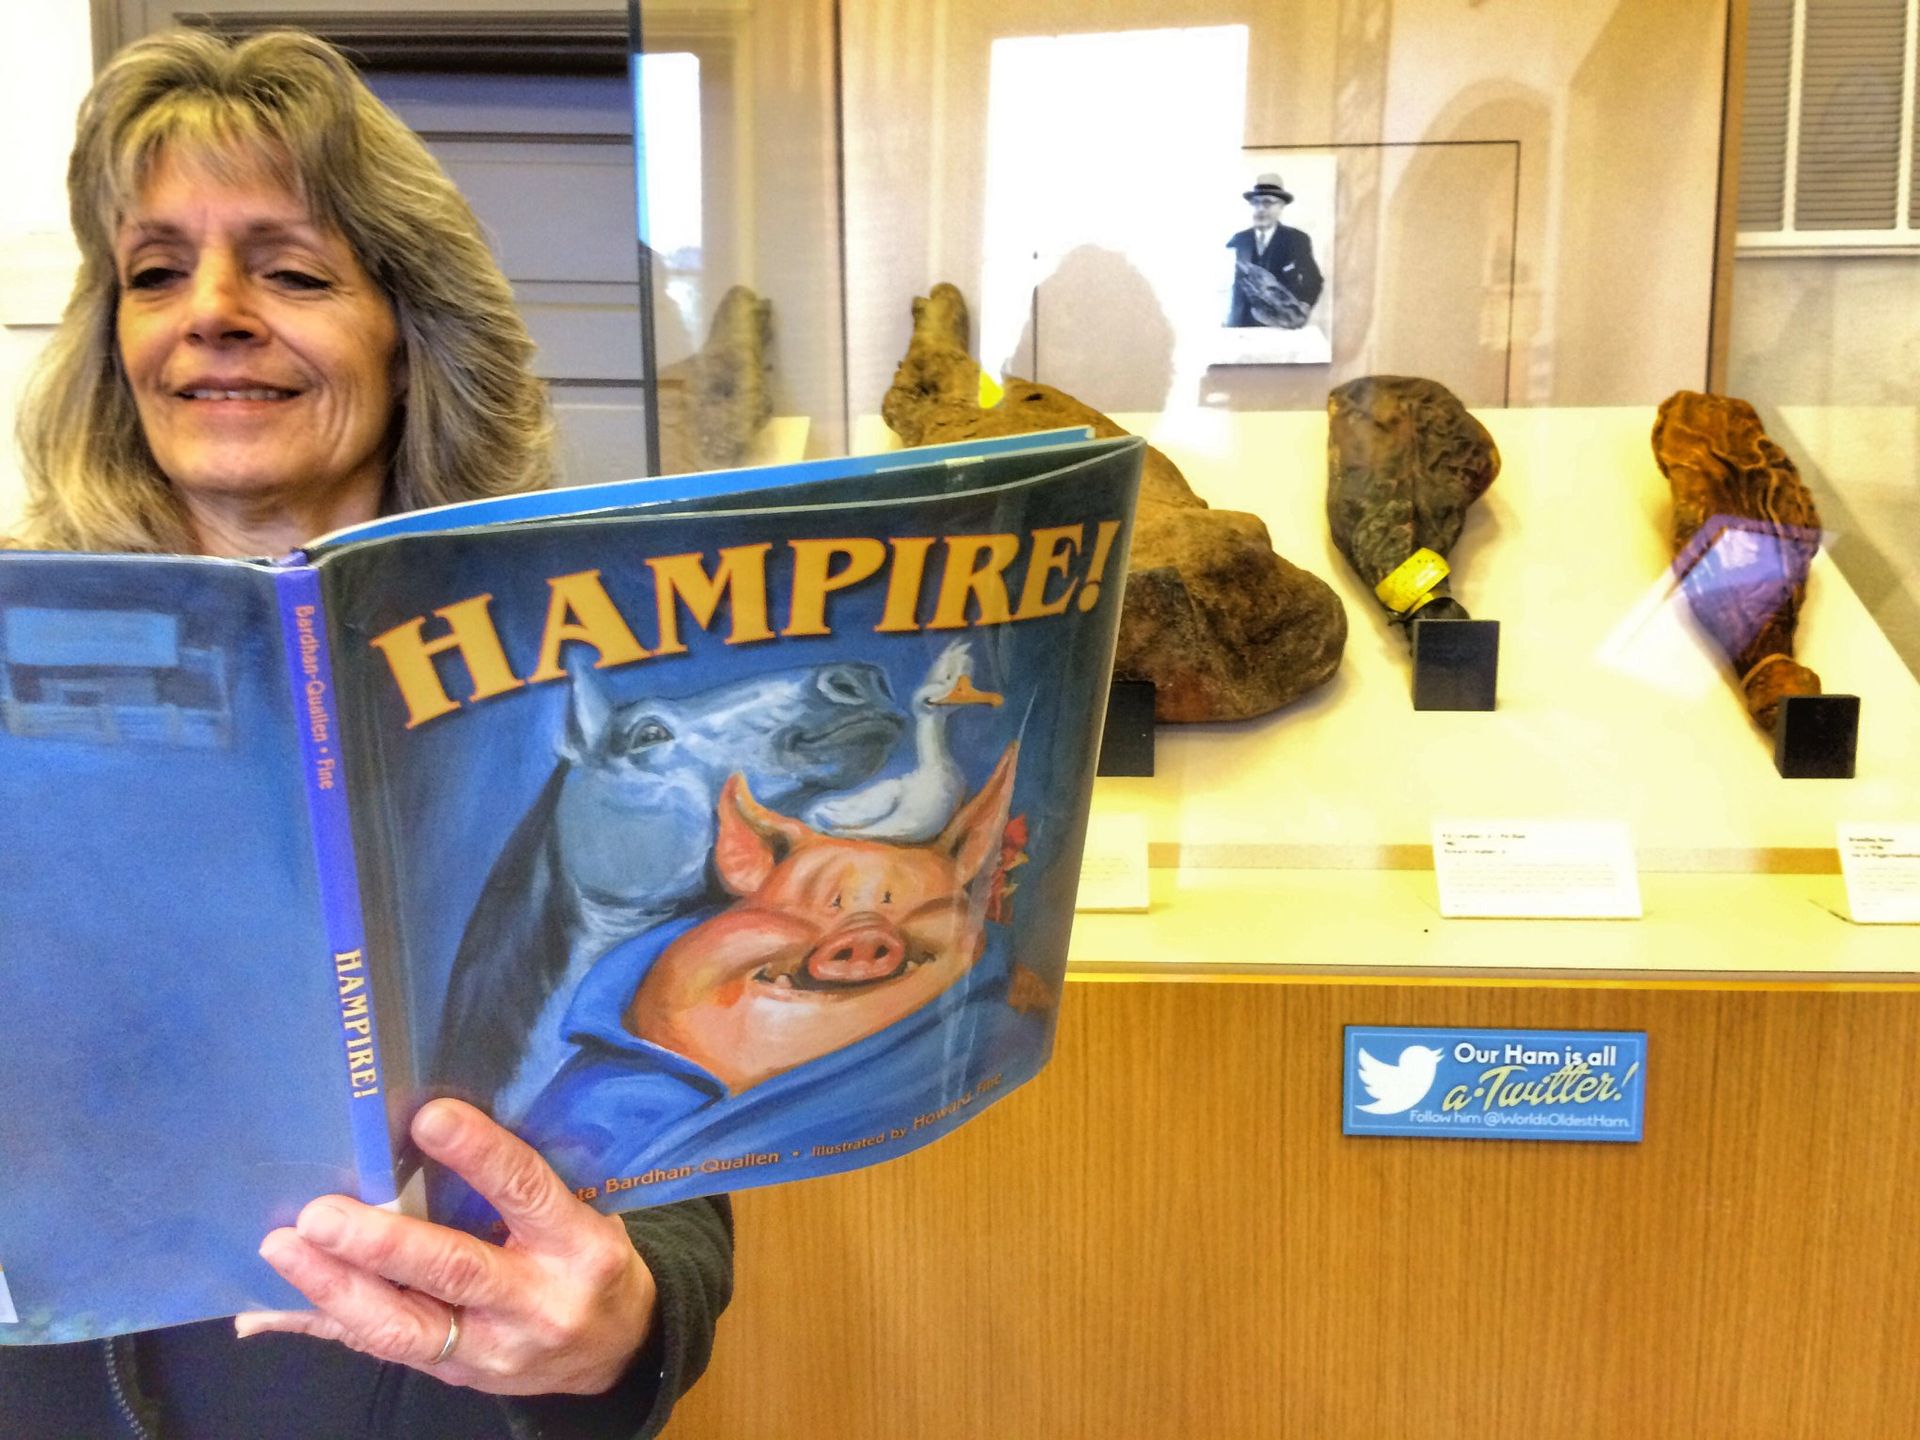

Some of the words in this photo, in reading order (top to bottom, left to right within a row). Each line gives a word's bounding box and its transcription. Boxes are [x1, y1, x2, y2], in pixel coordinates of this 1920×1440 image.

[369, 520, 1121, 730] HAMPIRE!
[316, 758, 336, 789] Fine
[335, 949, 378, 1098] HAMPIRE!
[1454, 1042, 1499, 1064] Our
[1504, 1045, 1560, 1065] Ham
[1565, 1045, 1583, 1067] is
[1587, 1045, 1617, 1067] all
[1409, 1109, 1451, 1124] Follow
[1454, 1111, 1482, 1125] him
[812, 1132, 885, 1157] Illustrated
[890, 1128, 907, 1139] by
